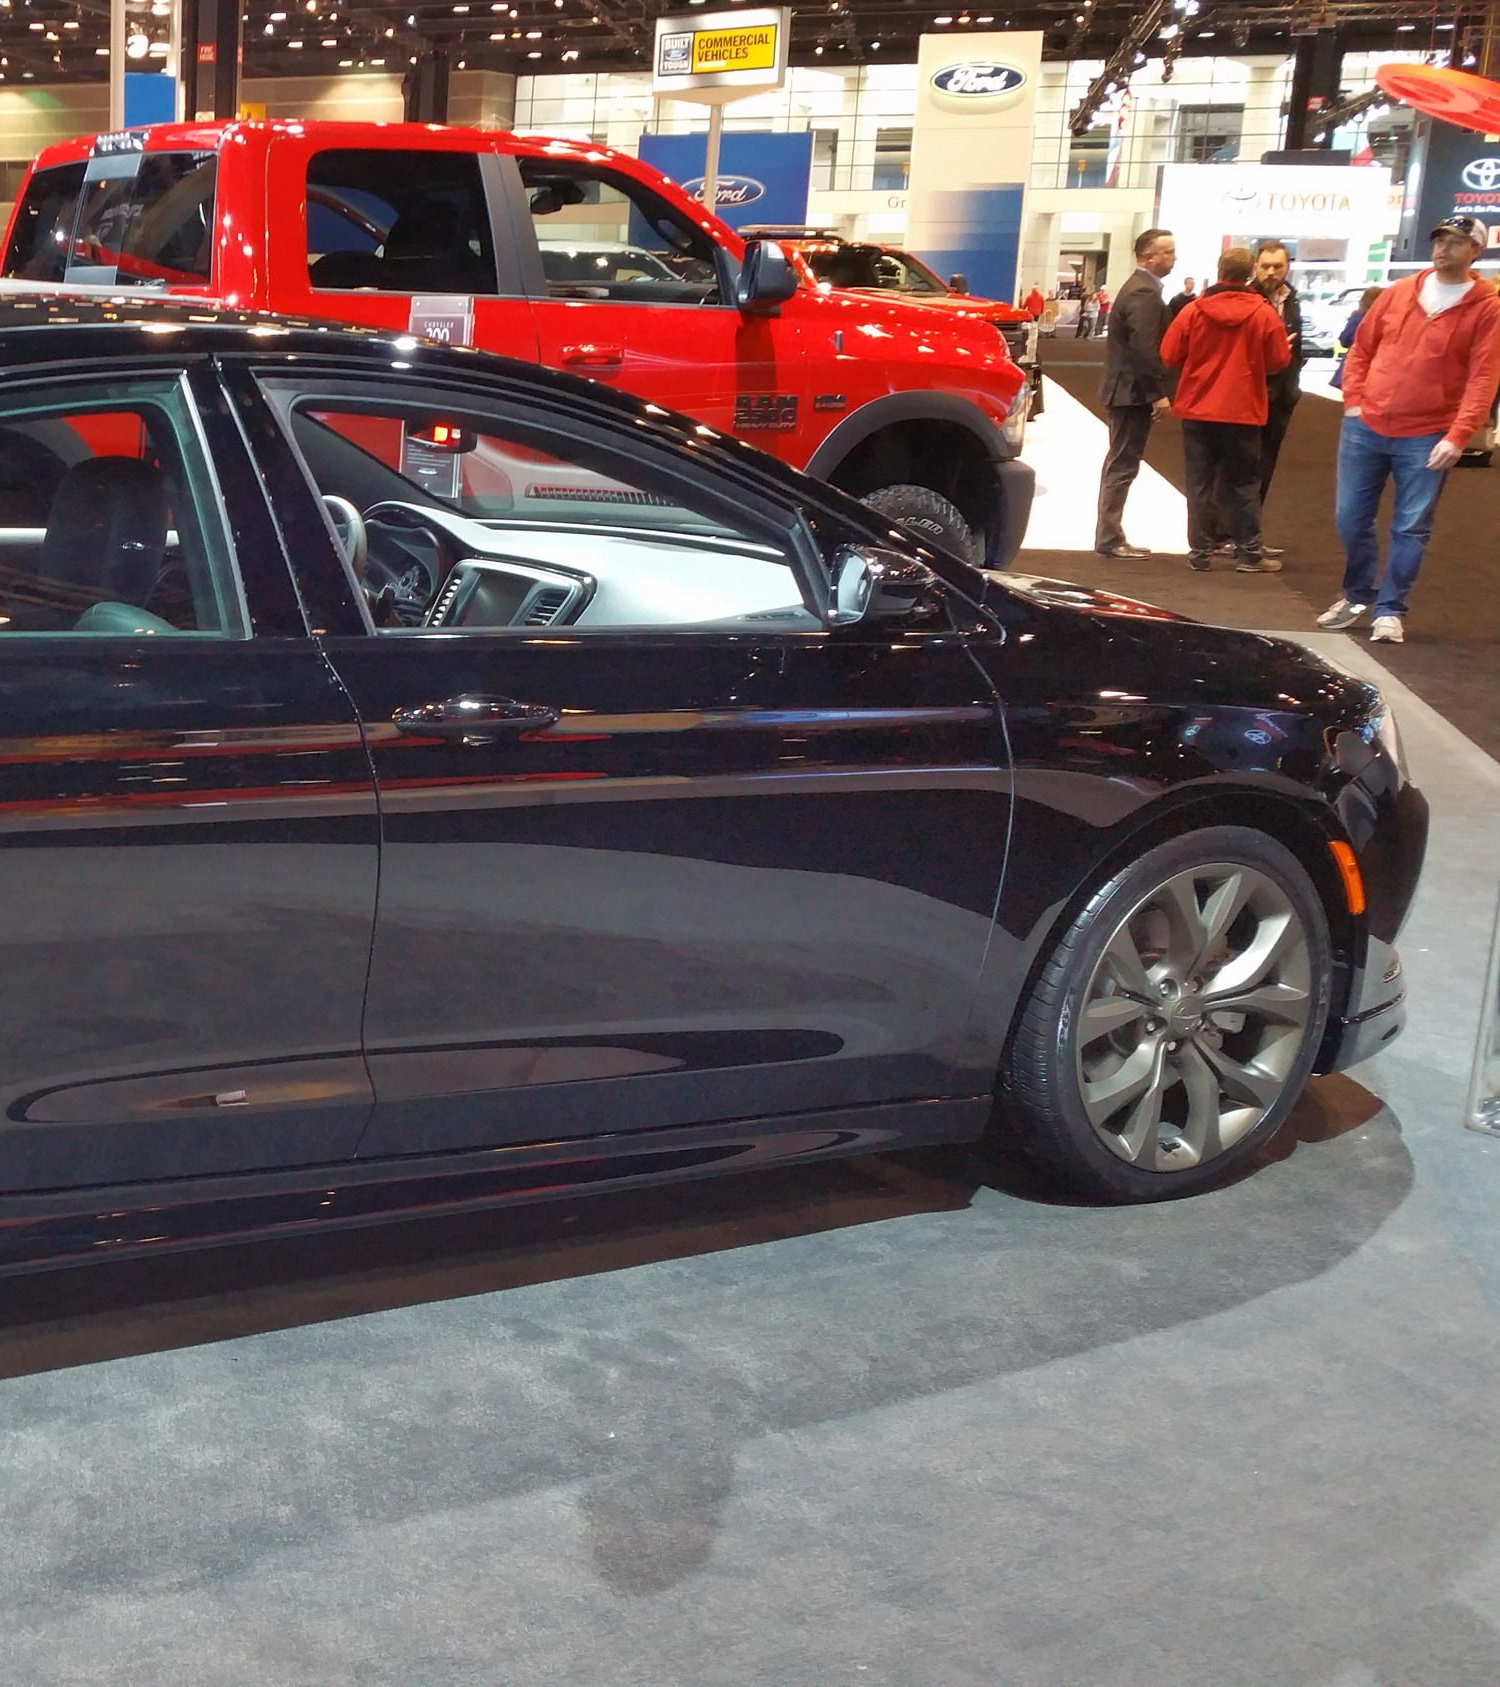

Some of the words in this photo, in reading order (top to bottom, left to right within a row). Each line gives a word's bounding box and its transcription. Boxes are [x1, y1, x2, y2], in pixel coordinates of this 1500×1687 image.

[665, 37, 690, 50] BUILT
[698, 33, 771, 50] COMMERCIAL
[698, 47, 749, 62] VEHICLES
[663, 60, 689, 71] TOUGH
[946, 66, 1010, 92] Ford
[1268, 192, 1350, 212] TOYOTA
[735, 394, 798, 408] RAM
